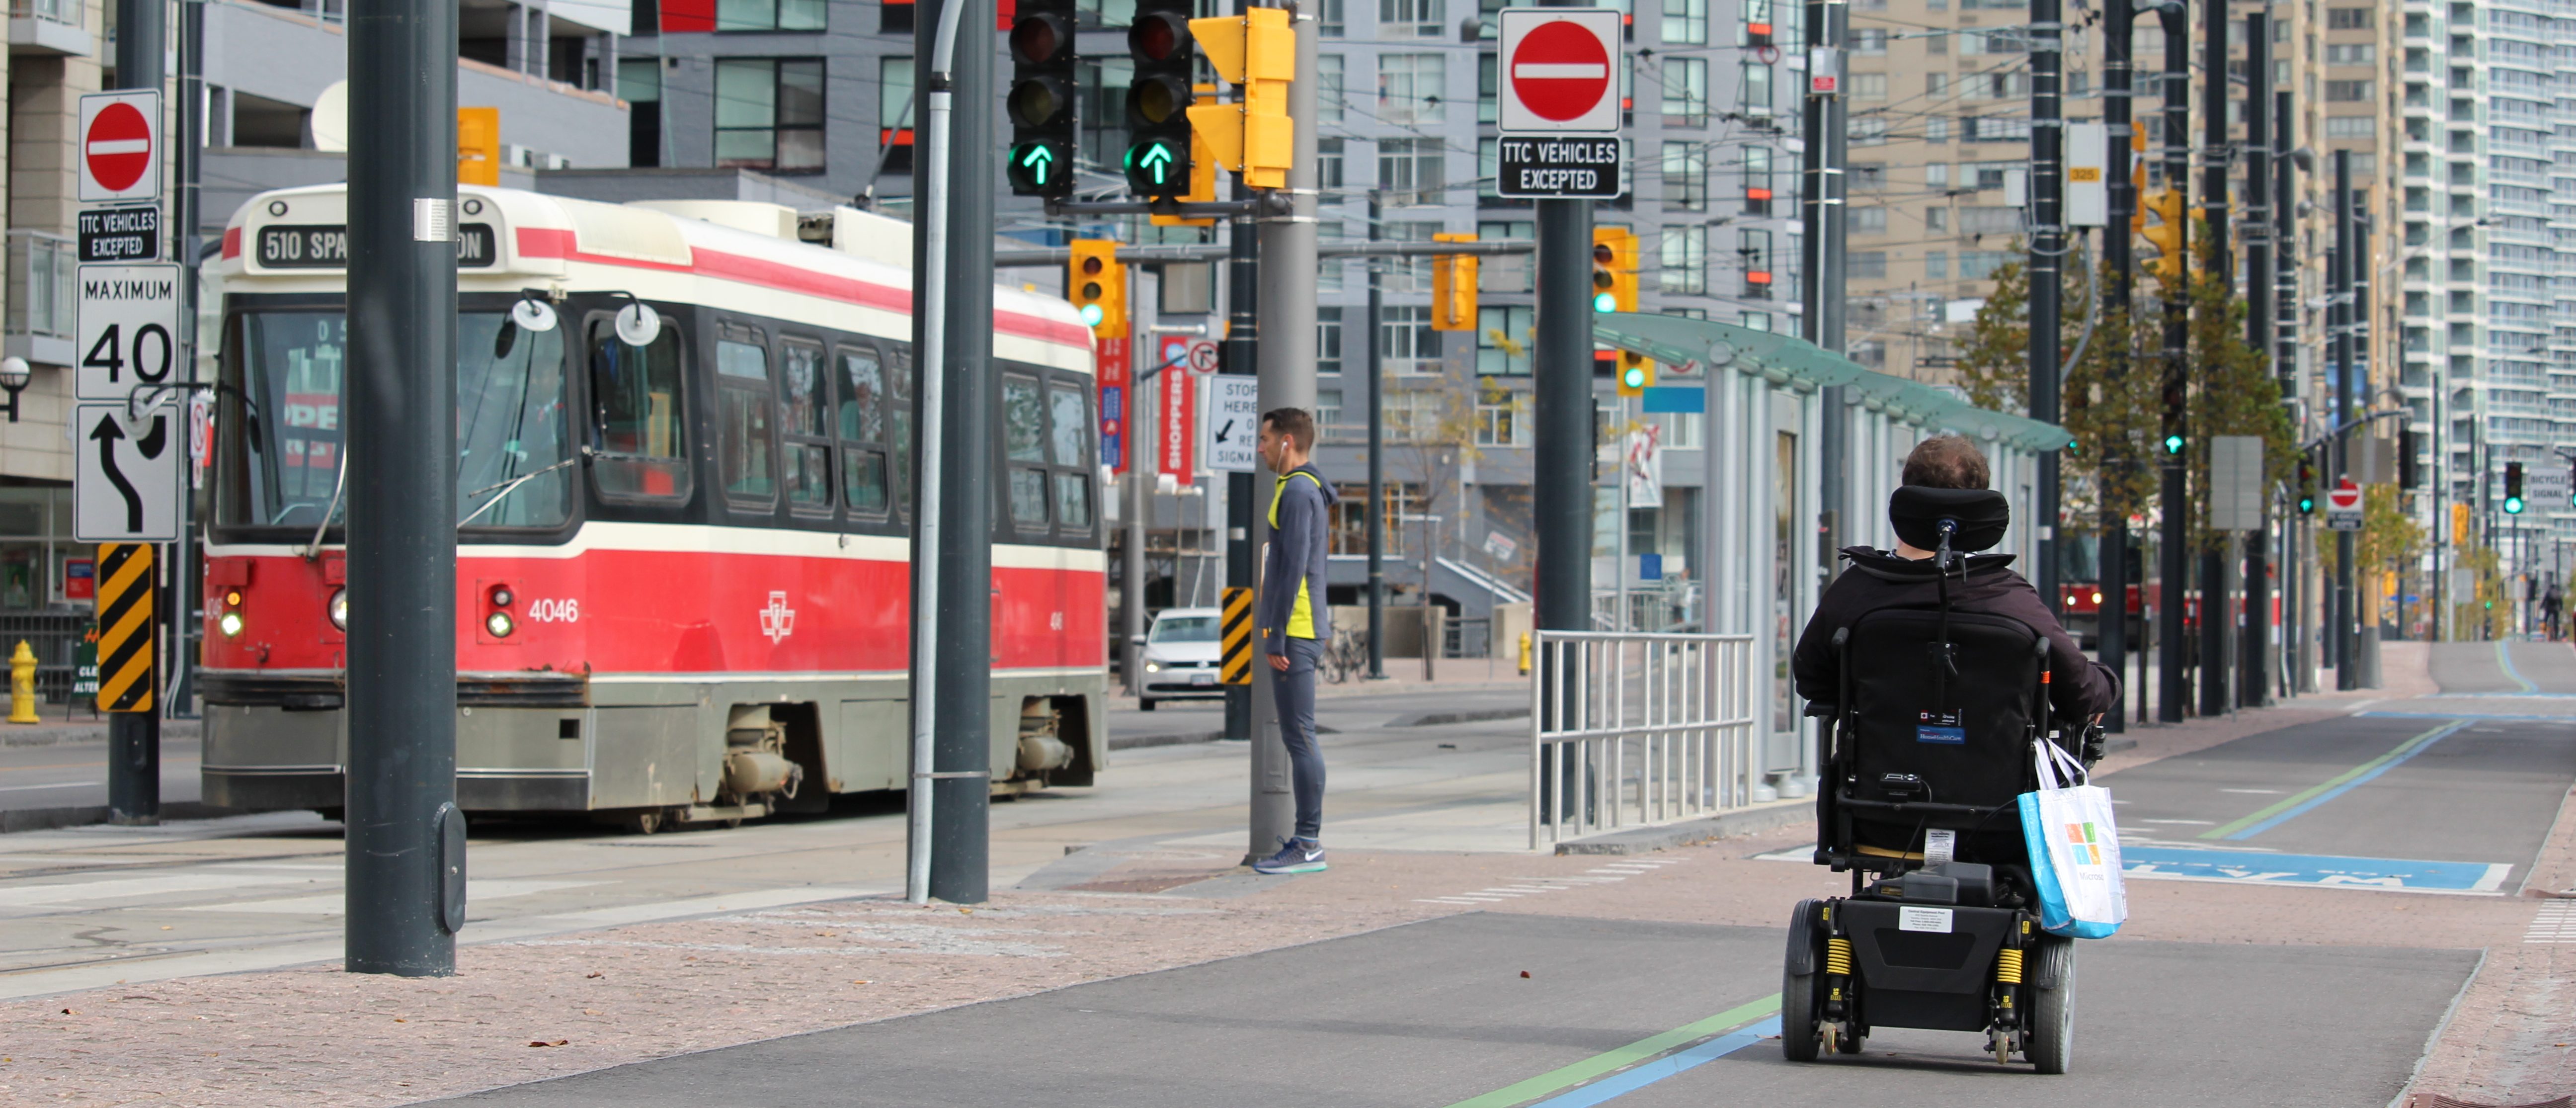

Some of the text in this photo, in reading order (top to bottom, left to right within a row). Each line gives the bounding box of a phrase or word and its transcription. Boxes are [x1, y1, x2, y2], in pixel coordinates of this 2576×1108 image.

[1503, 143, 1616, 164] TTC VEHICLES
[1521, 169, 1597, 189] EXCEPTED
[80, 212, 156, 233] TTC VEHICLES
[92, 237, 143, 256] EXCEPTED
[266, 232, 301, 259] 510
[85, 280, 172, 300] MAXIMUM
[82, 323, 172, 383] 40
[1224, 401, 1257, 414] HERE
[1169, 370, 1183, 470] SHOPPERS
[1246, 419, 1254, 430] O
[1239, 435, 1254, 447] RE
[1218, 450, 1253, 463] SIGNA
[2530, 476, 2565, 484] BICYCLE
[2533, 490, 2564, 499] SIGNAL
[529, 598, 578, 622] 4046
[79, 666, 98, 678] CLE
[74, 682, 99, 693] ALTER
